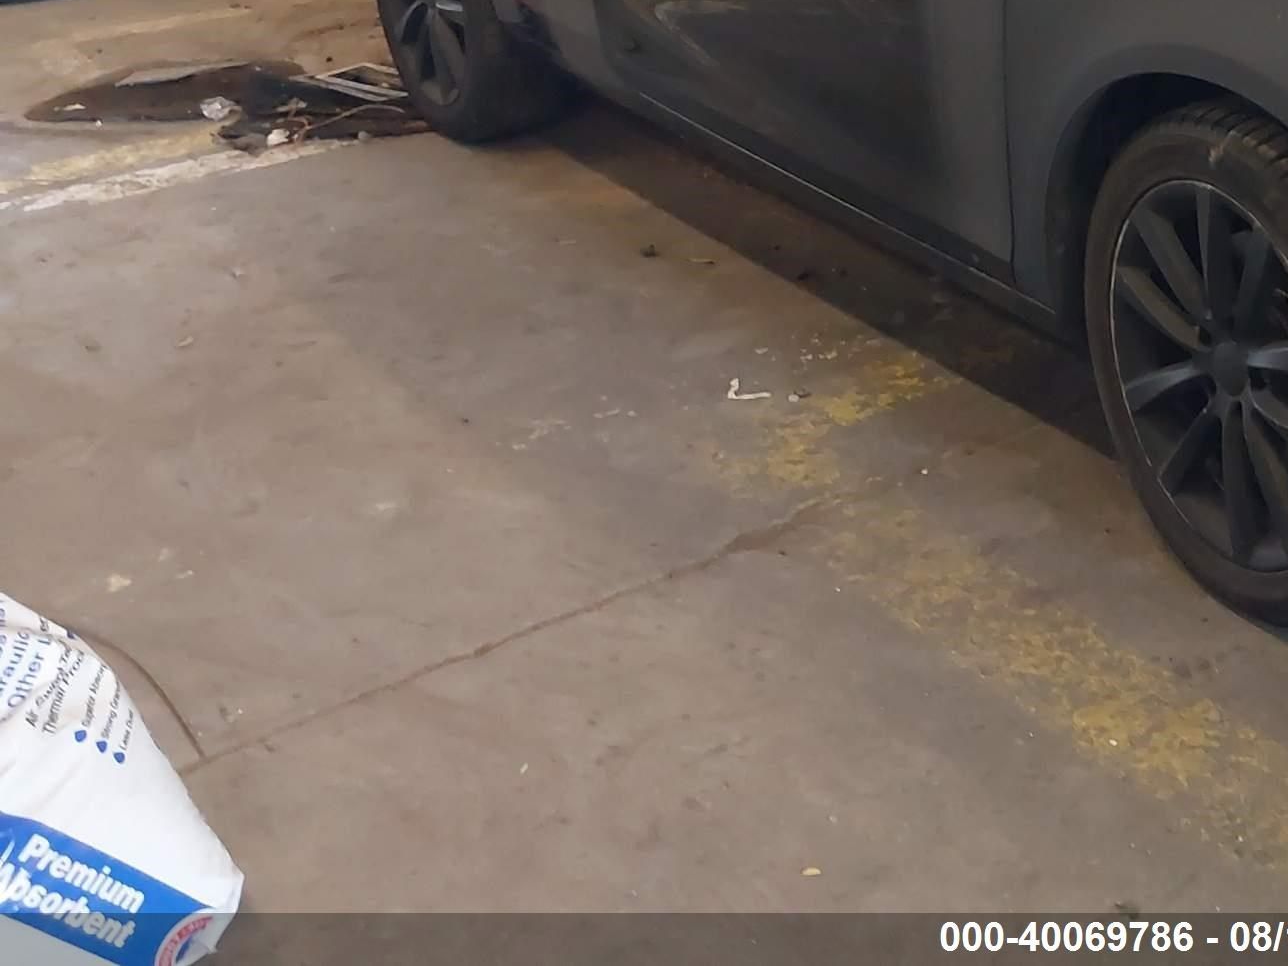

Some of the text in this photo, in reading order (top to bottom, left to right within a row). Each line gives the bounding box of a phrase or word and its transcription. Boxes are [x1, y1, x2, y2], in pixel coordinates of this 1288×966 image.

[7, 652, 45, 708] Other
[0, 862, 136, 948] Absorbent
[18, 833, 145, 914] Premium
